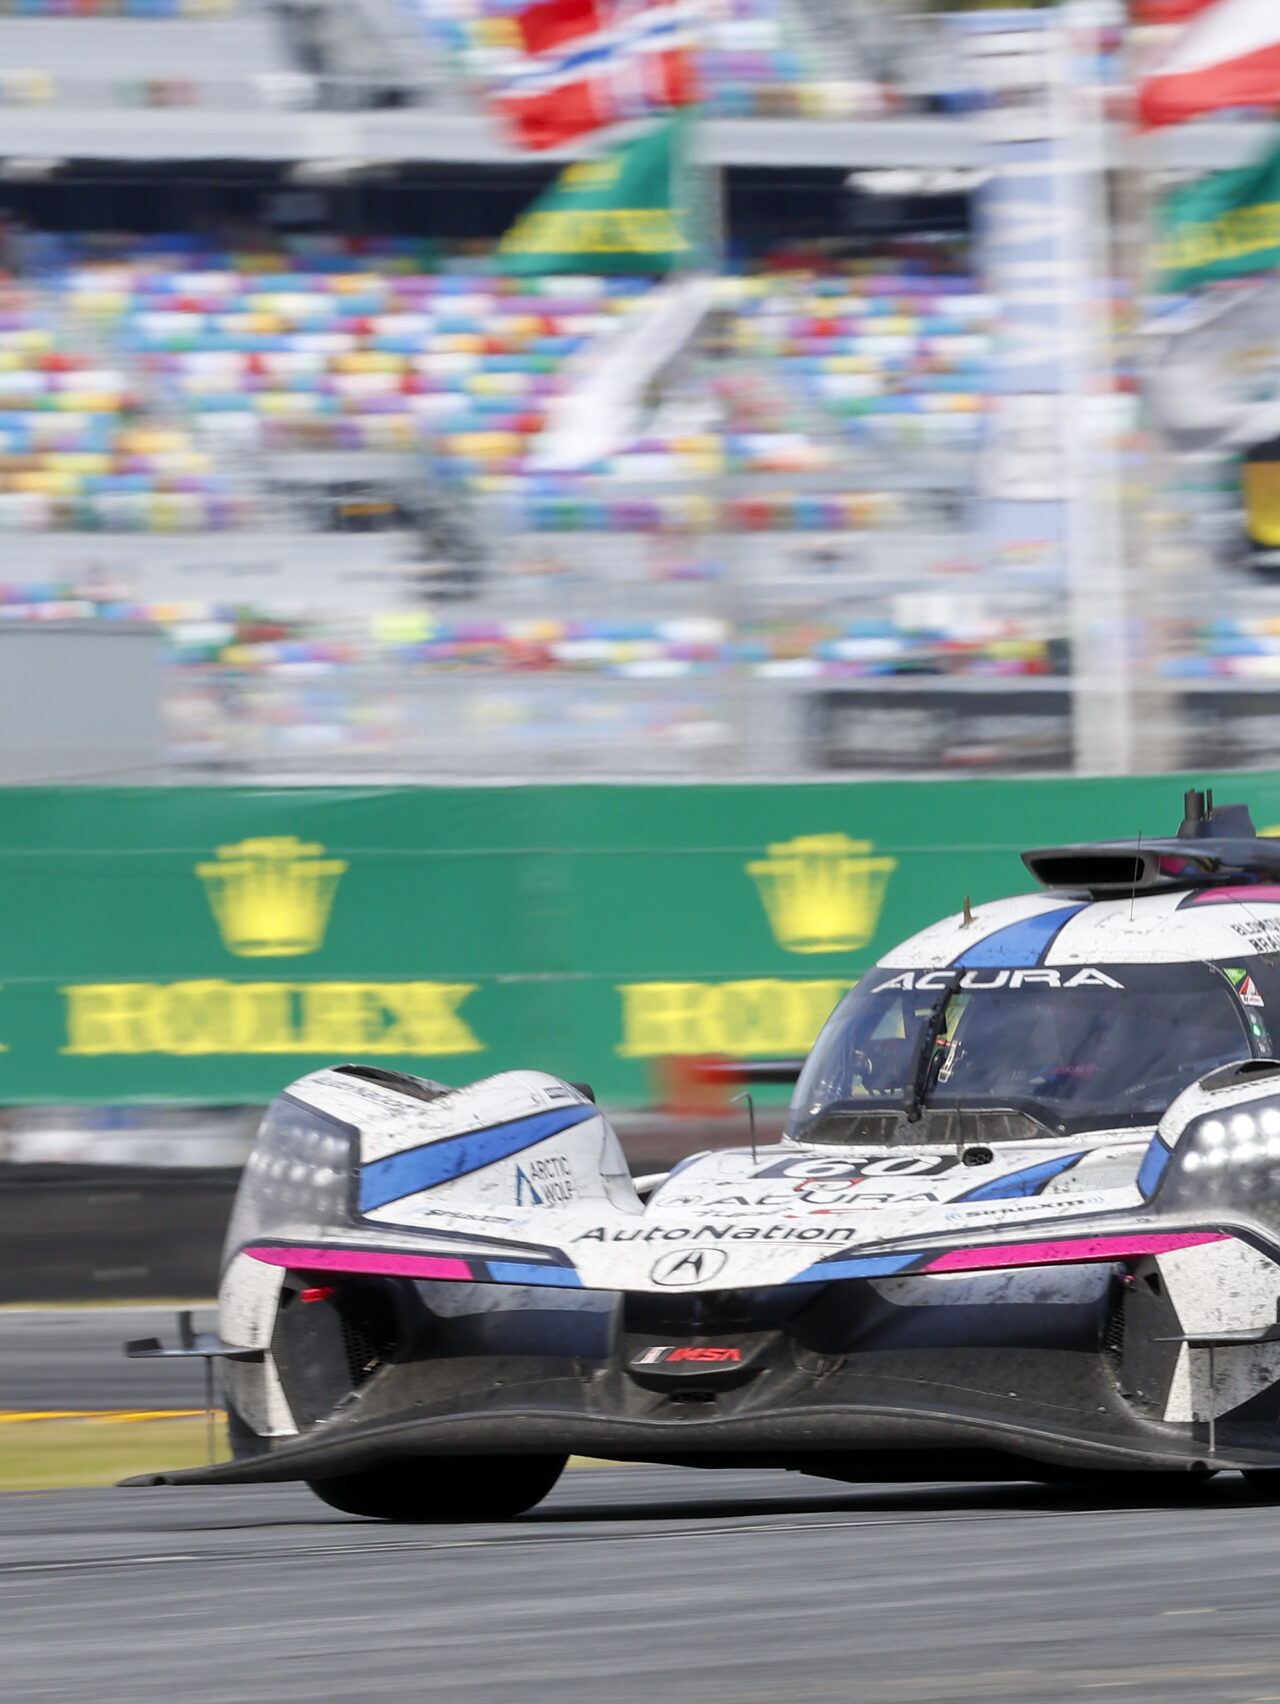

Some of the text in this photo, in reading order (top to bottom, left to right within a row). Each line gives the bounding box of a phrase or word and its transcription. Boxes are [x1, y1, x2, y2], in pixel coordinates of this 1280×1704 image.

[871, 968, 1125, 993] ACURA
[58, 979, 486, 1055] ROLEX
[613, 979, 858, 1058] ROL
[530, 1155, 573, 1181] ARCTIC
[782, 1156, 942, 1178] 60
[539, 1180, 575, 1205] WOLF
[704, 1191, 940, 1206] ACURA
[571, 1224, 857, 1243] AutoNation
